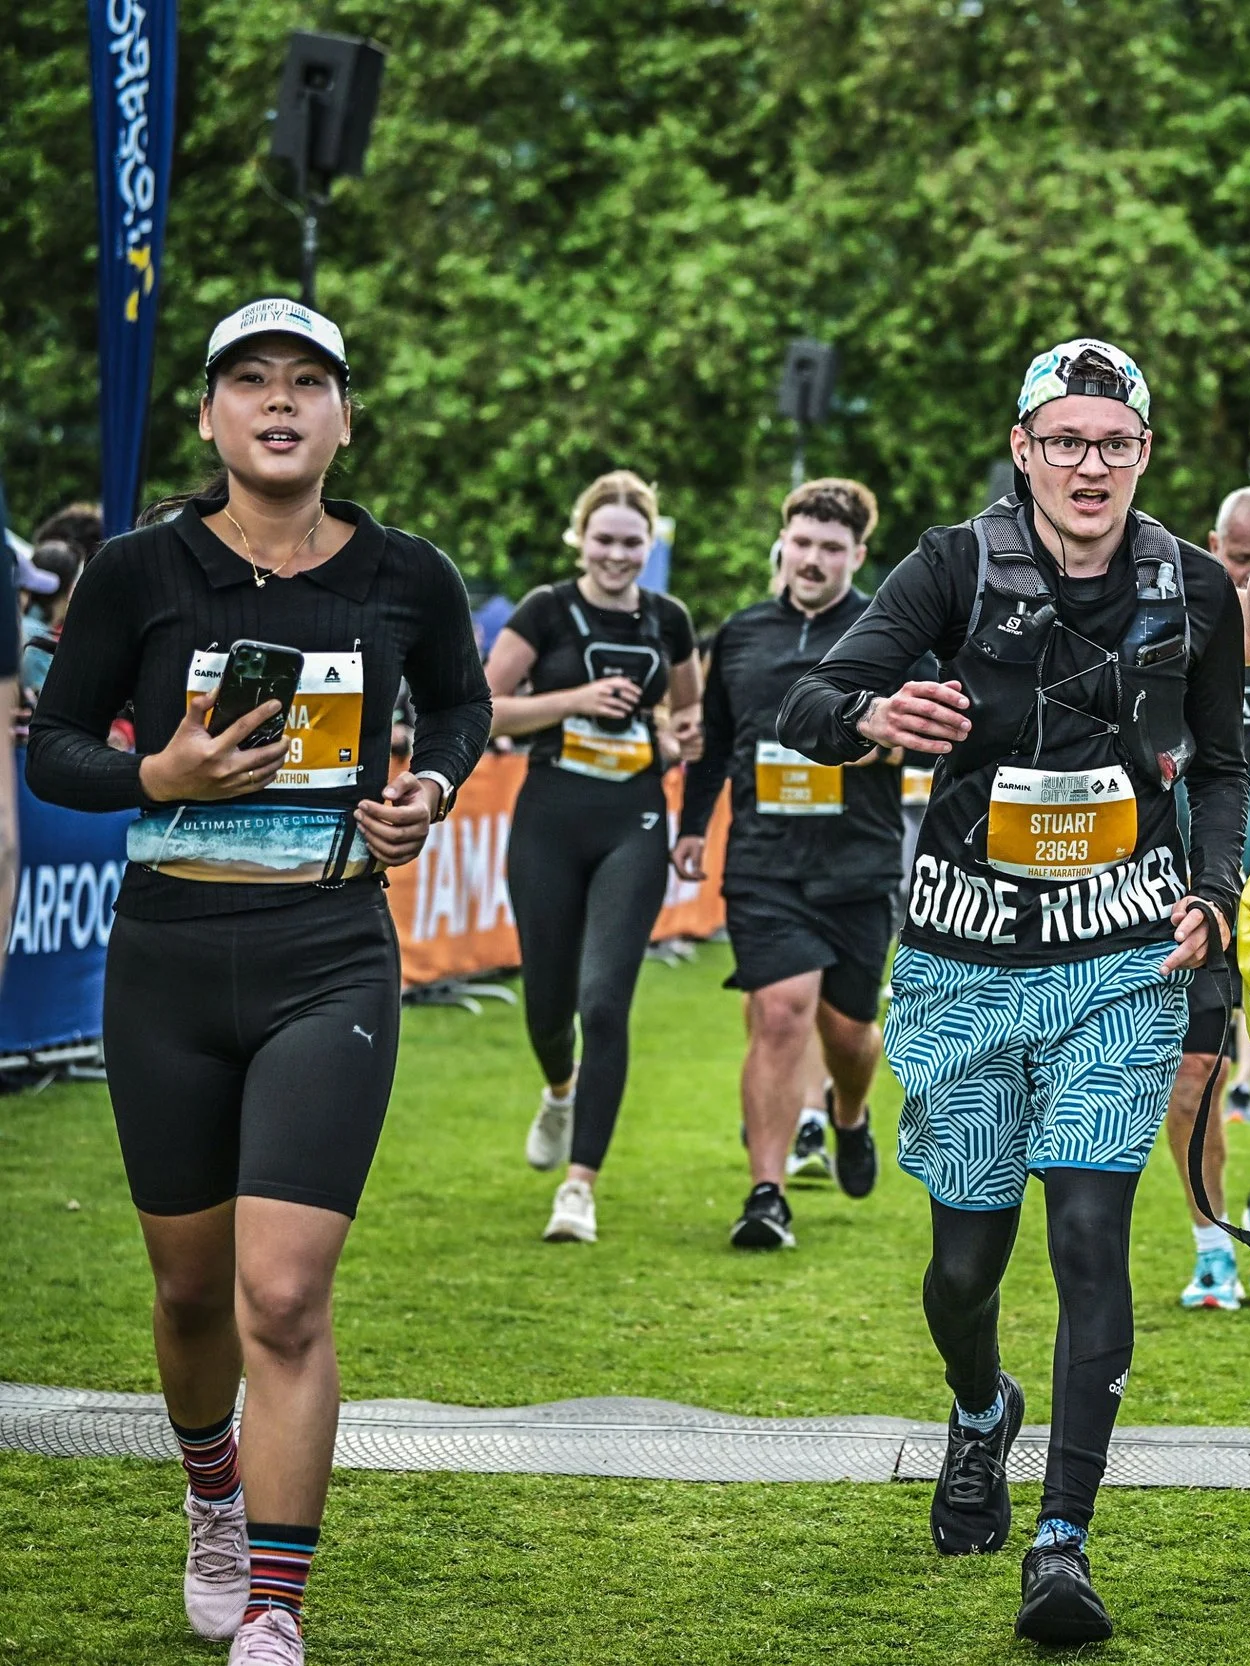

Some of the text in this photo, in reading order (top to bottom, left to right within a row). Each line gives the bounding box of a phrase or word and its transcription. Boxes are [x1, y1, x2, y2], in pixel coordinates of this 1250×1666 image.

[194, 669, 224, 678] GARM
[183, 814, 335, 831] ULTIMATE DIRECTION
[1030, 812, 1097, 834] STUART
[1035, 840, 1088, 861] 23643
[1028, 867, 1092, 877] HALF MARATHON
[909, 853, 1019, 945] GUIDE
[1039, 845, 1187, 943] RUNNER
[8, 860, 128, 955] ARFOO
